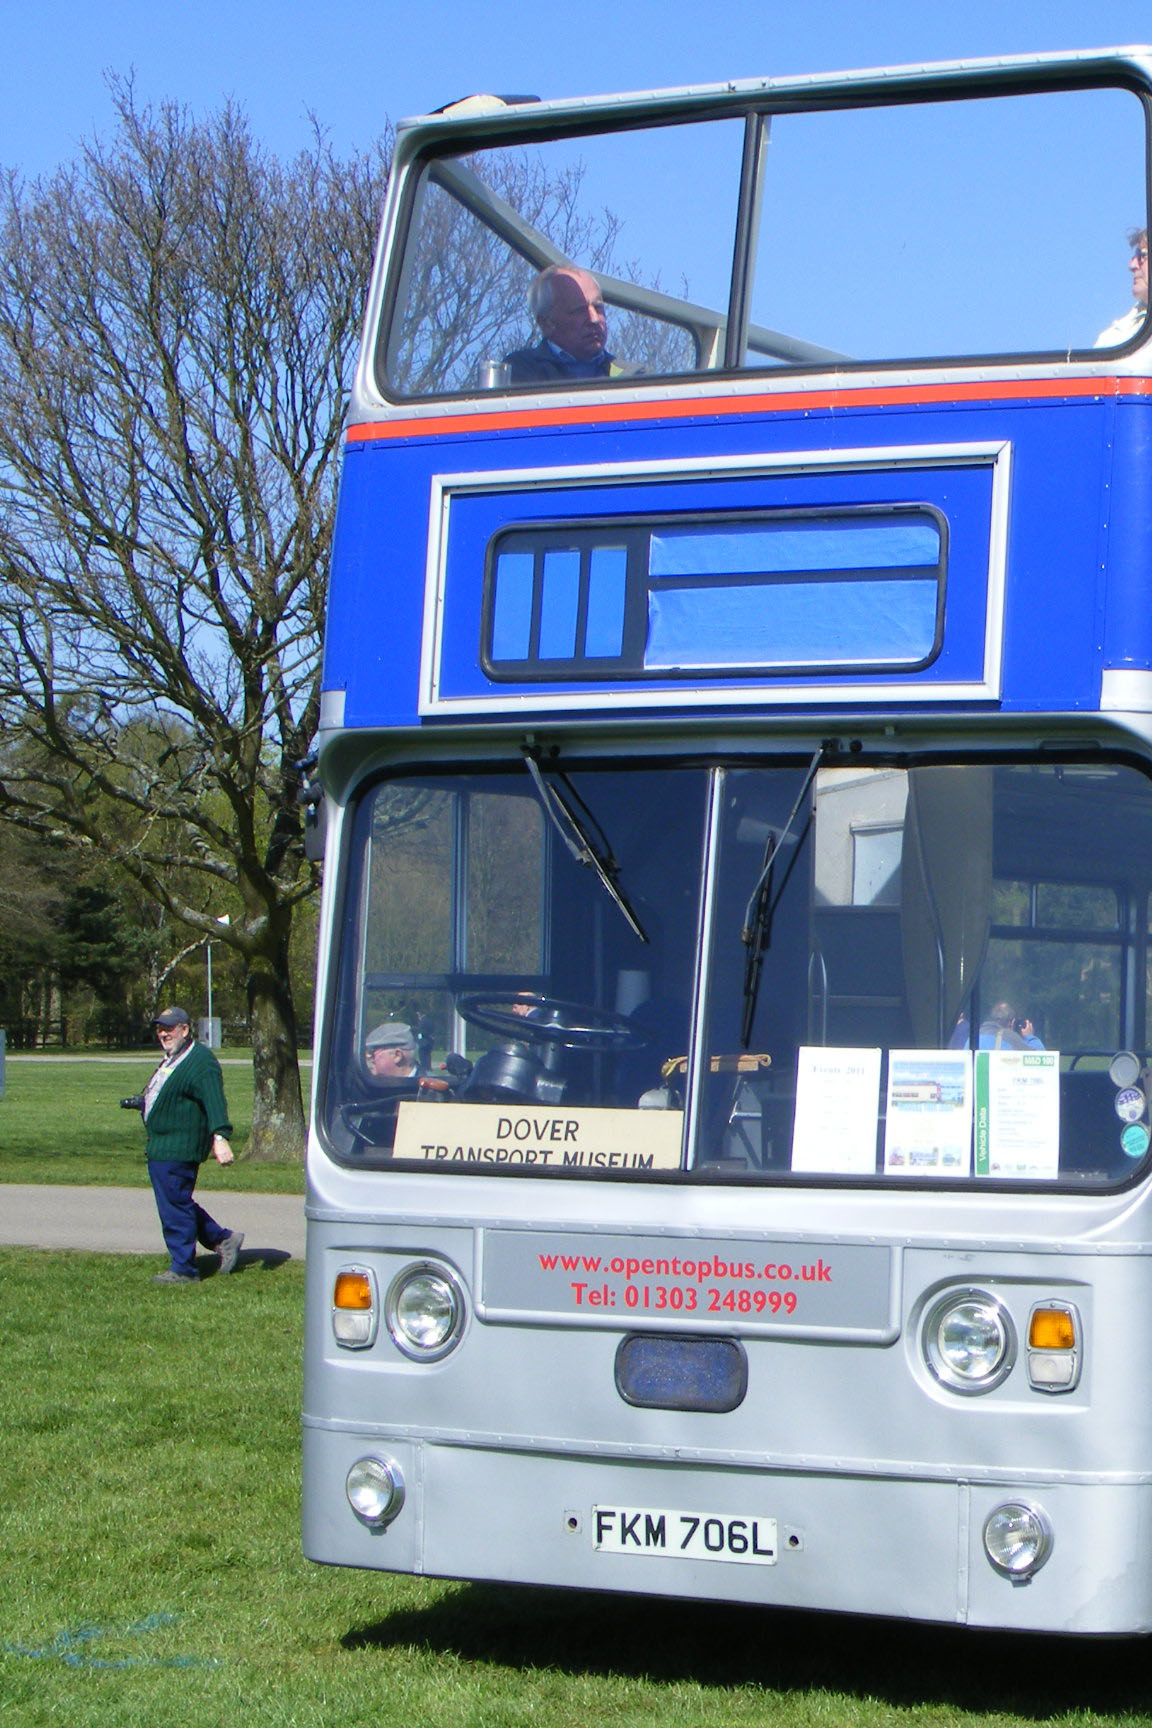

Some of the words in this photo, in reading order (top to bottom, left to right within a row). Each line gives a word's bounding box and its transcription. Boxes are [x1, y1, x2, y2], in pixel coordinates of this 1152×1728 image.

[496, 1118, 579, 1141] DOVER
[979, 1107, 988, 1128] Data
[421, 1145, 553, 1164] TRANSPORT
[563, 1151, 654, 1169] MUSEUM
[979, 1129, 988, 1161] Vehicle
[538, 1254, 832, 1283] www.opentopbus.co.uk
[571, 1282, 616, 1307] Tel:
[624, 1285, 698, 1311] 01303
[707, 1287, 798, 1314] 248999
[596, 1511, 666, 1548] FKM
[680, 1516, 774, 1556] 706L
